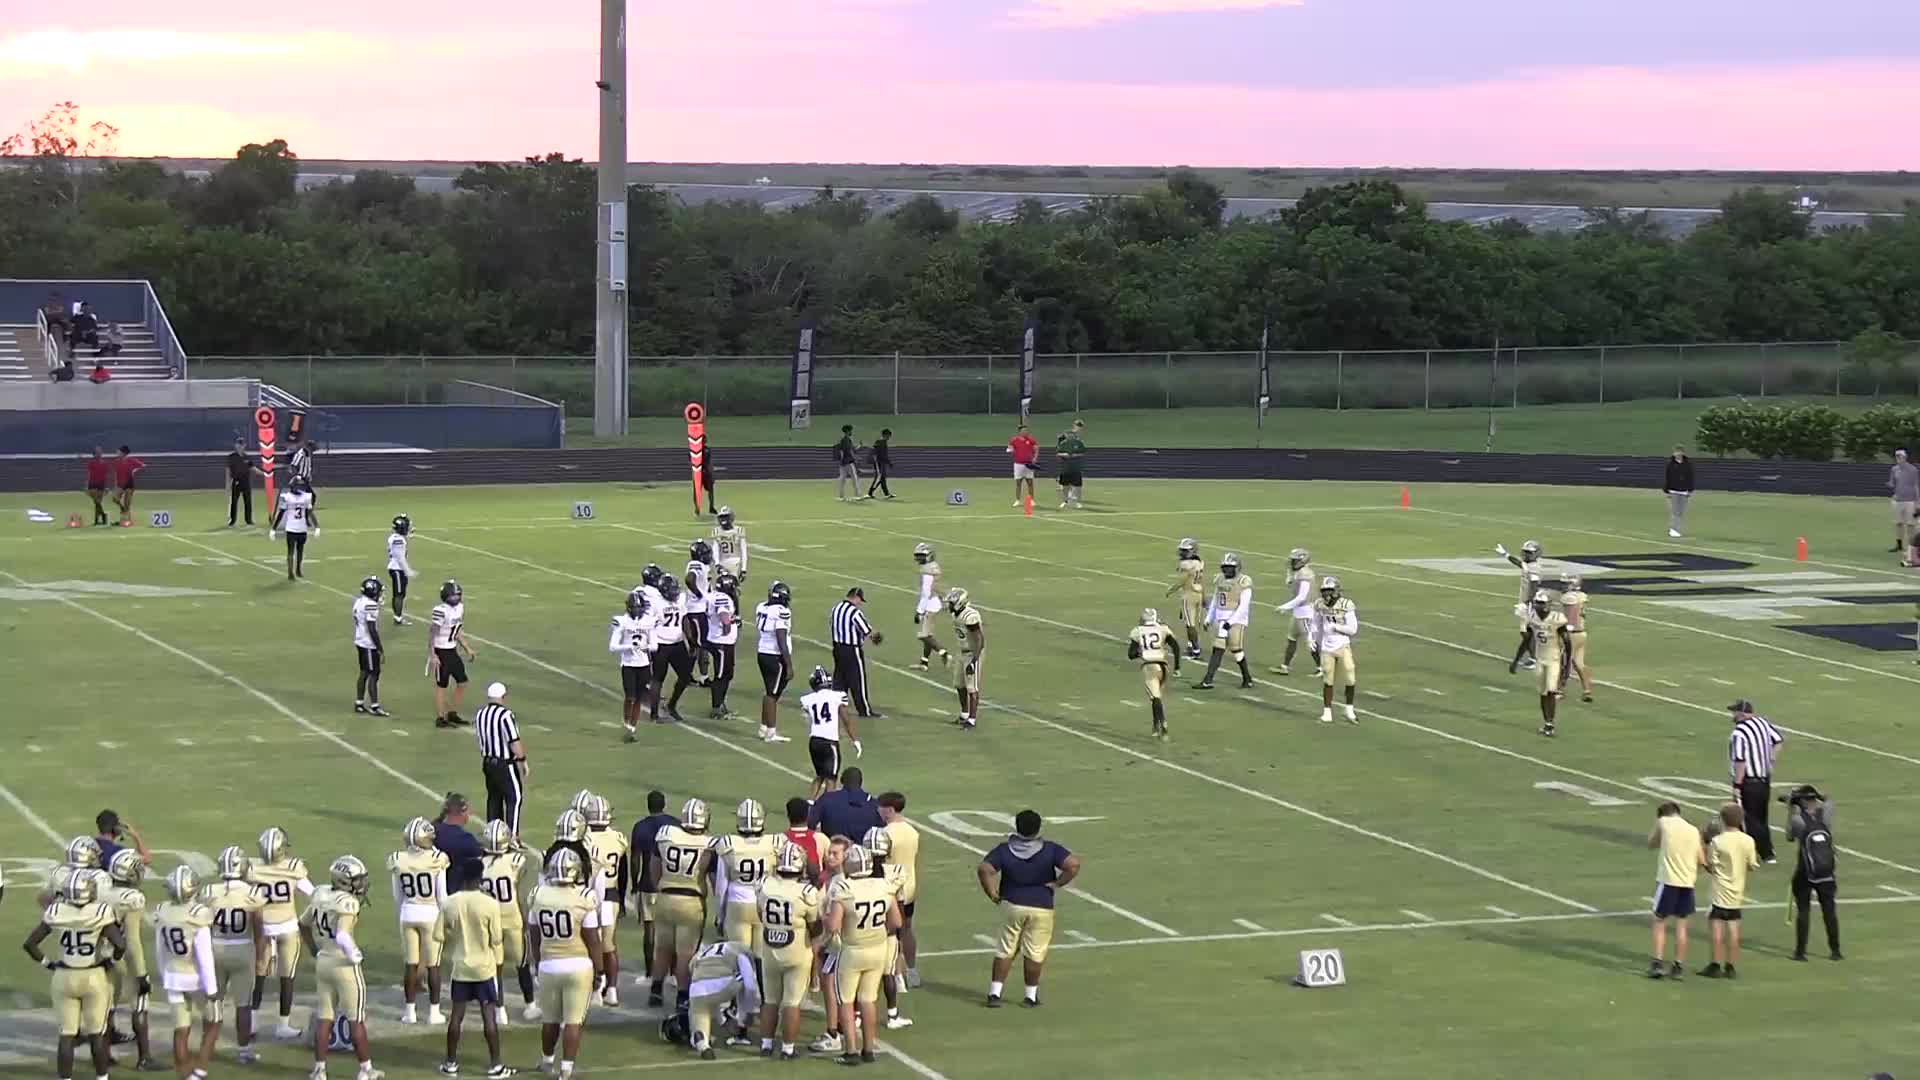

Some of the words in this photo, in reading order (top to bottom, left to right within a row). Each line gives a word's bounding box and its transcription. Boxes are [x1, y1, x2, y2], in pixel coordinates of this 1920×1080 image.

[954, 492, 963, 503] G
[153, 512, 169, 525] 20
[577, 505, 591, 517] 10
[721, 541, 735, 554] 21
[663, 612, 680, 627] 71
[1142, 633, 1161, 650] 12
[811, 701, 832, 725] 14
[666, 846, 699, 876] 97
[740, 858, 765, 883] 91
[213, 908, 247, 934] 40
[313, 908, 337, 939] 14
[539, 909, 572, 938] 60
[766, 898, 792, 926] 61
[855, 899, 886, 930] 72
[60, 929, 95, 957] 45
[161, 926, 188, 956] 18
[1309, 954, 1338, 982] 20
